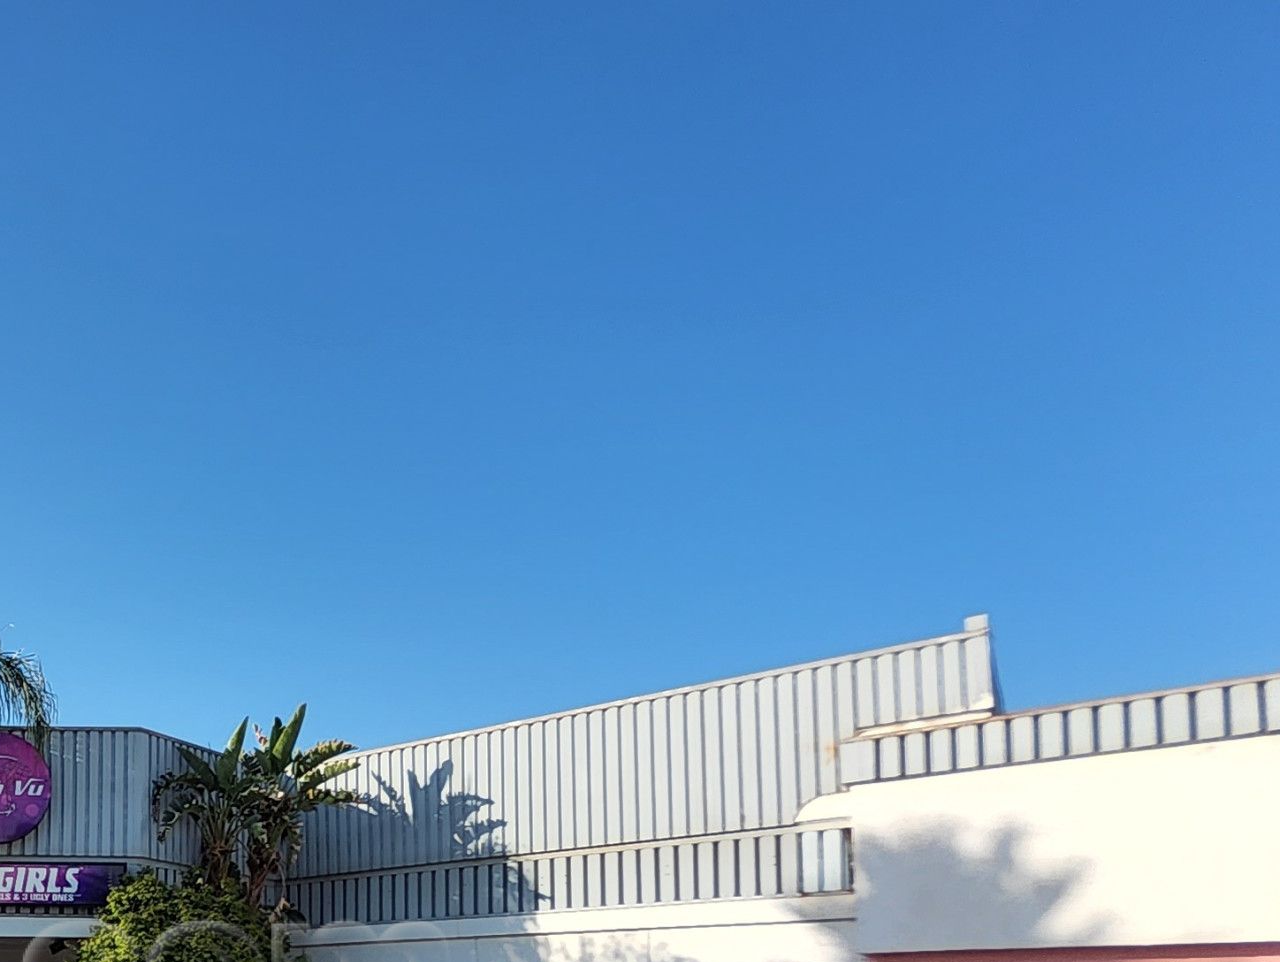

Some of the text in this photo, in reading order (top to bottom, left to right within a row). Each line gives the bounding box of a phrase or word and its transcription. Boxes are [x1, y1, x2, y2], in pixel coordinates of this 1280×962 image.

[14, 778, 45, 796] Vu
[13, 893, 20, 901] &
[22, 893, 28, 901] 3
[30, 893, 51, 902] UGLY
[52, 894, 74, 902] ONES
